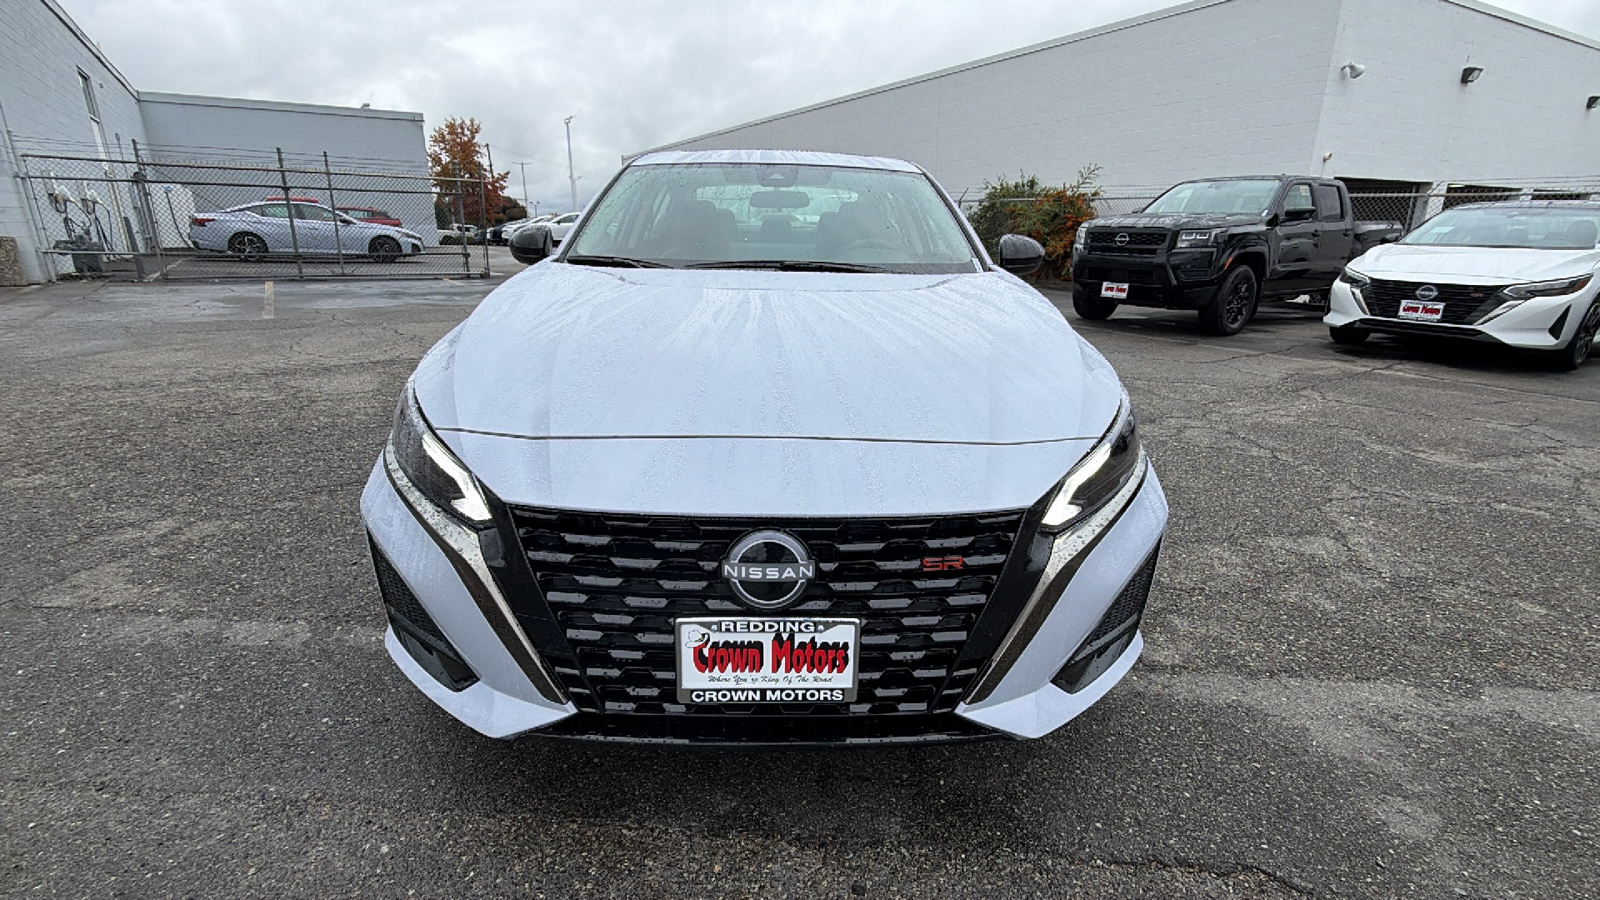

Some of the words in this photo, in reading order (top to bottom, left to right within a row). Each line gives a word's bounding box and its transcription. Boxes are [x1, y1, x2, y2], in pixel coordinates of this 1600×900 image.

[923, 556, 963, 572] SR
[724, 564, 813, 579] NISSAN
[721, 621, 816, 632] REDDING
[692, 633, 764, 673] Crown
[771, 633, 850, 674] Motors
[708, 675, 731, 683] Where
[733, 675, 758, 685] You're
[761, 675, 779, 684] King
[782, 675, 793, 684] Of
[795, 675, 809, 683] The
[812, 675, 833, 683] Road
[691, 690, 761, 702] CROWN
[766, 690, 844, 701] MOTORS
